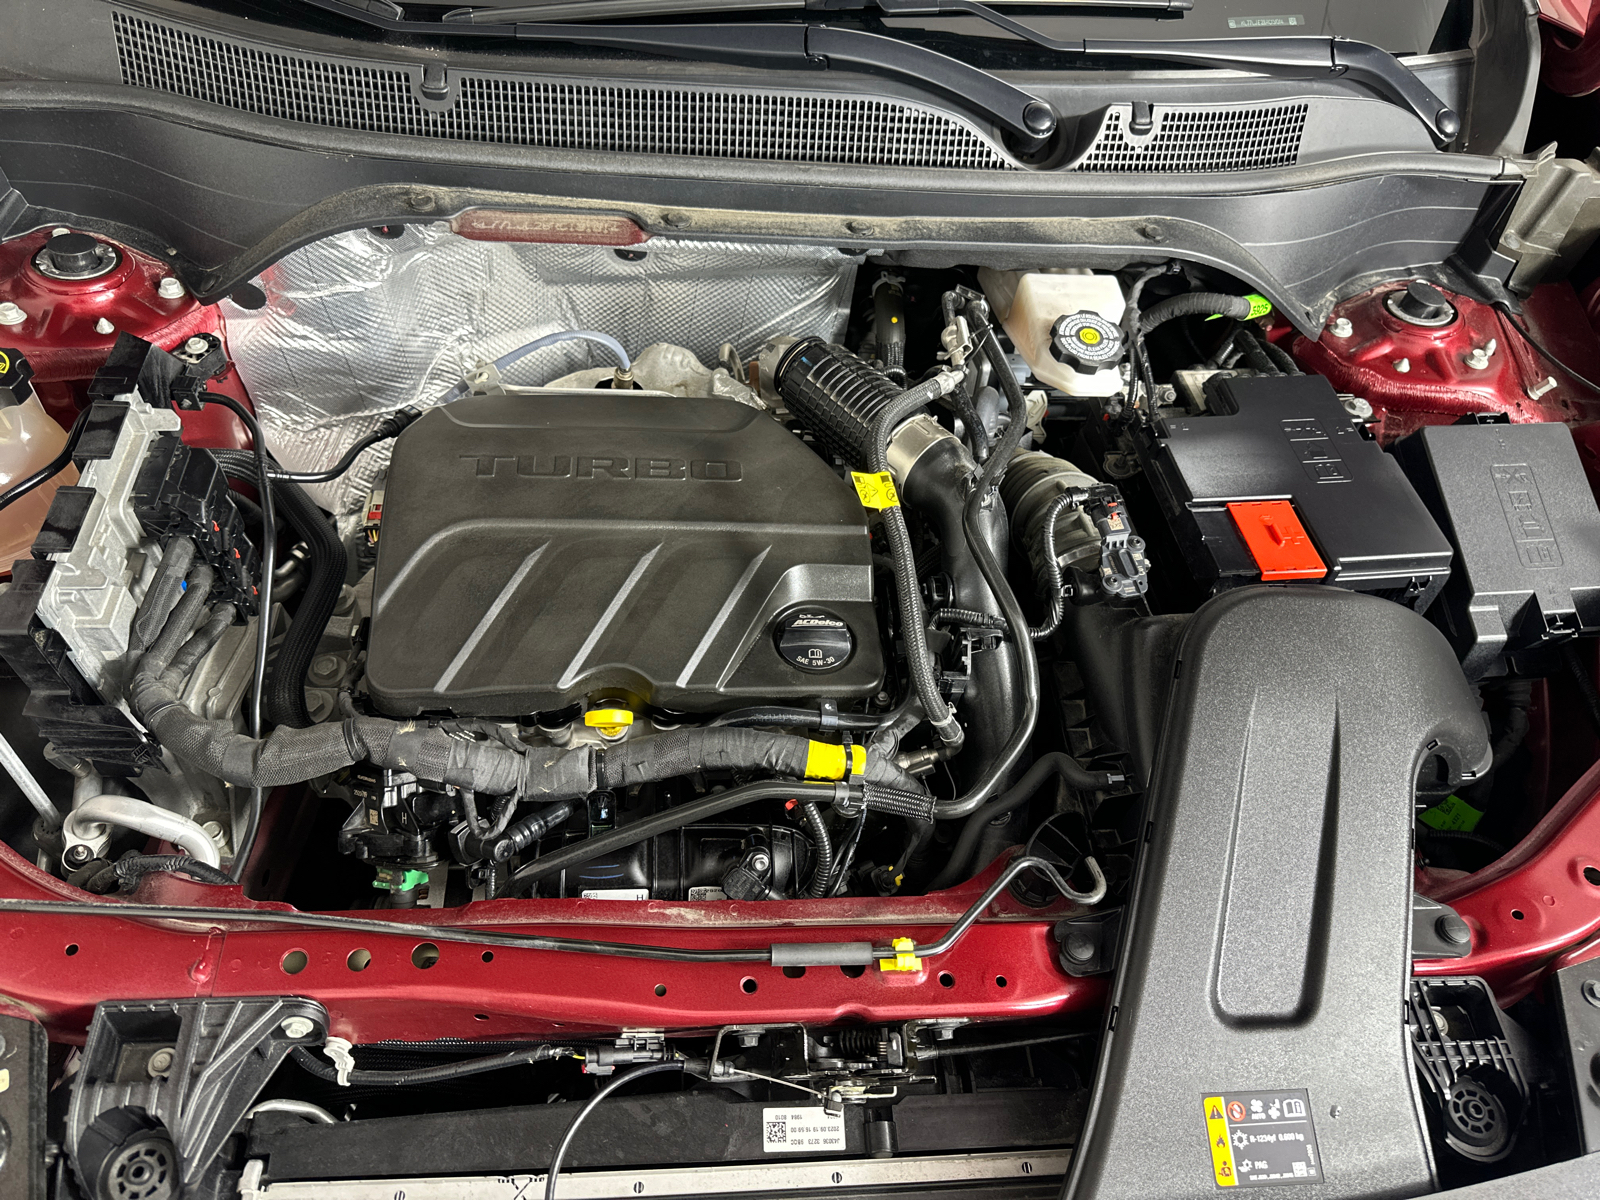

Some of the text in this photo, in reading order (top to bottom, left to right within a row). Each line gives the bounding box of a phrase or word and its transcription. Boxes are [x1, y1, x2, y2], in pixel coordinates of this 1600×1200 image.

[459, 455, 743, 482] TURBO
[791, 619, 844, 628] ACDelco
[796, 655, 835, 666] SAE 5W-30
[401, 812, 408, 824] H
[1254, 1160, 1268, 1170] PAG
